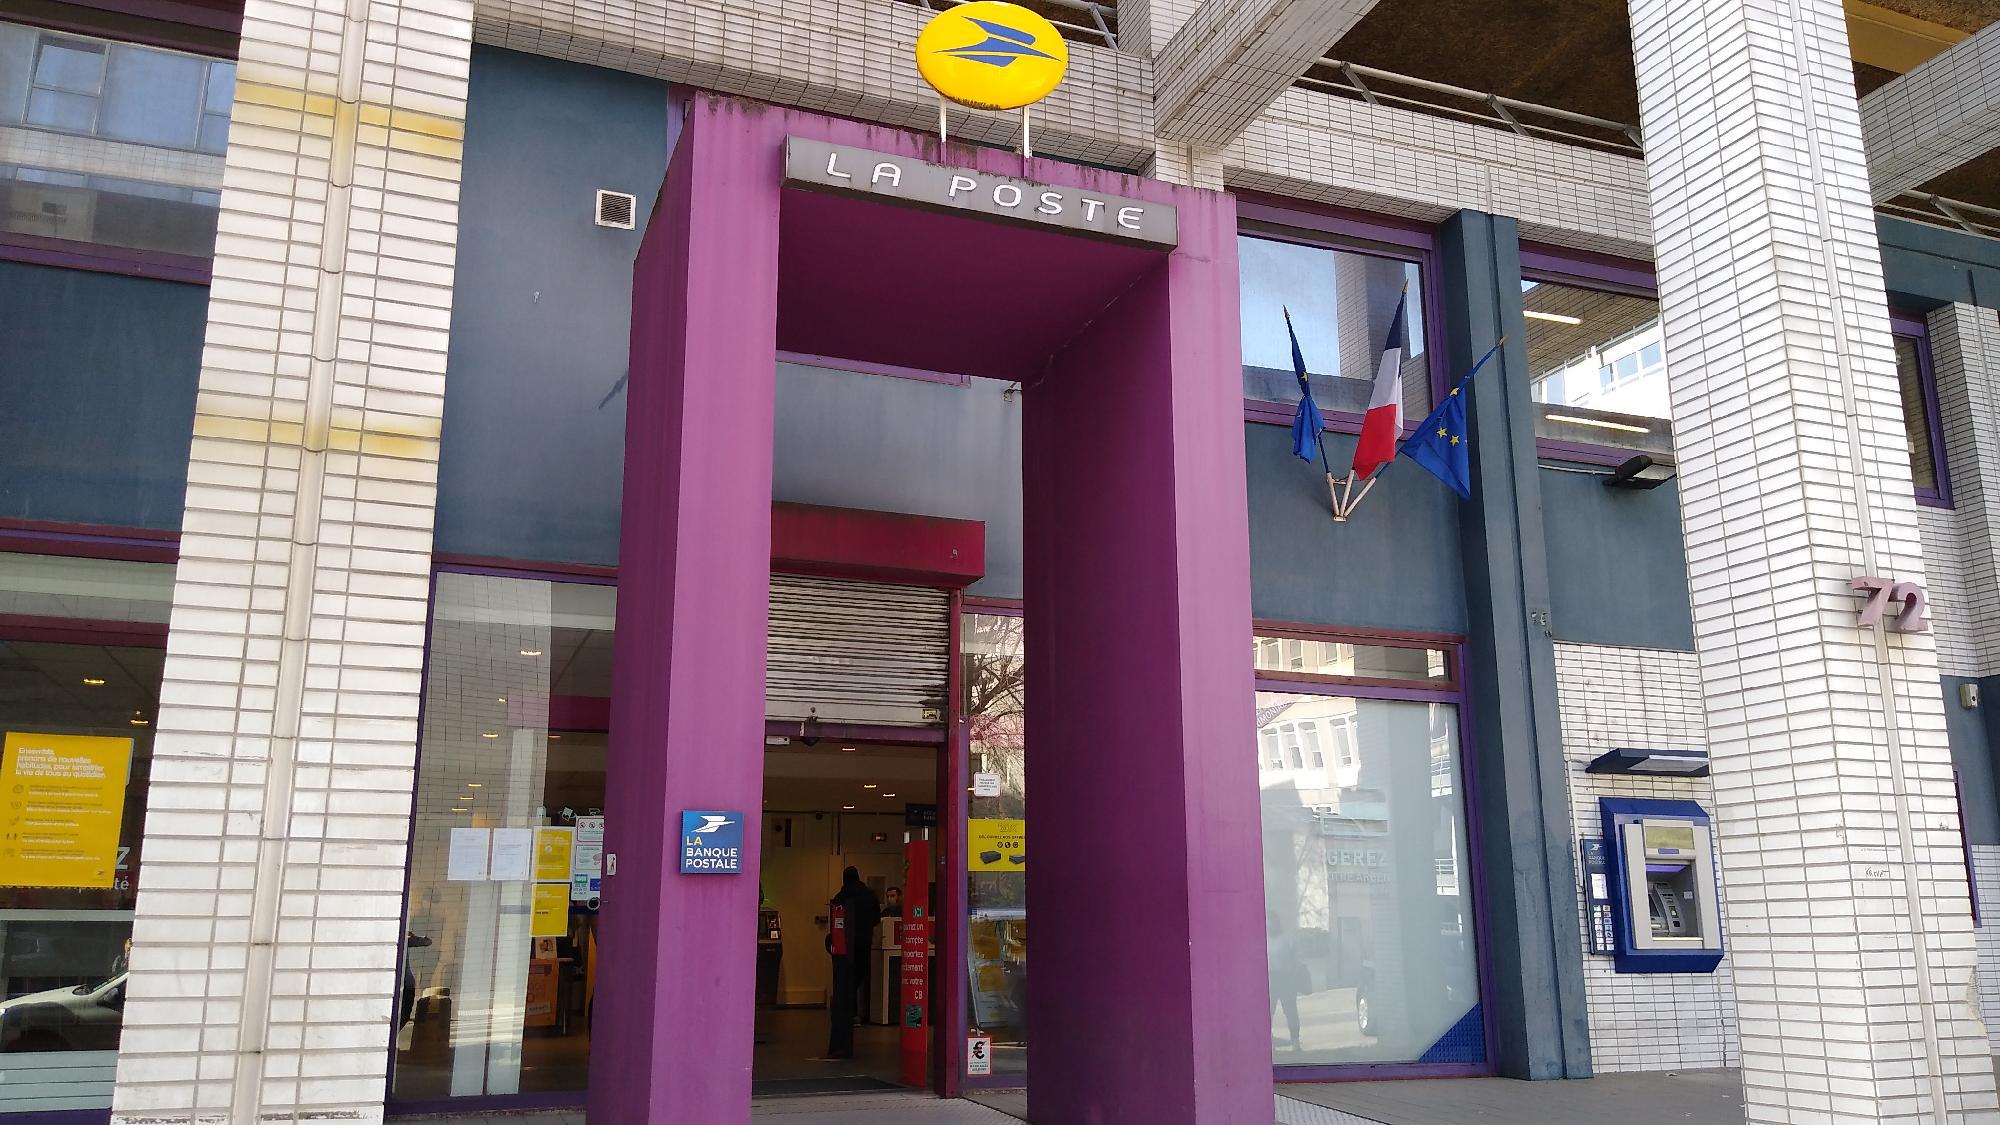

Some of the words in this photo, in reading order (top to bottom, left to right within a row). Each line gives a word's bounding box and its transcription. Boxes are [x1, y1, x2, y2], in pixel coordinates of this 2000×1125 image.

[826, 152, 901, 188] LA
[948, 174, 1145, 231] POSTE
[1851, 575, 1928, 633] 72
[686, 835, 702, 846] LA
[686, 847, 738, 858] BANQUE
[685, 858, 738, 869] POSTALE
[914, 990, 923, 1000] CB
